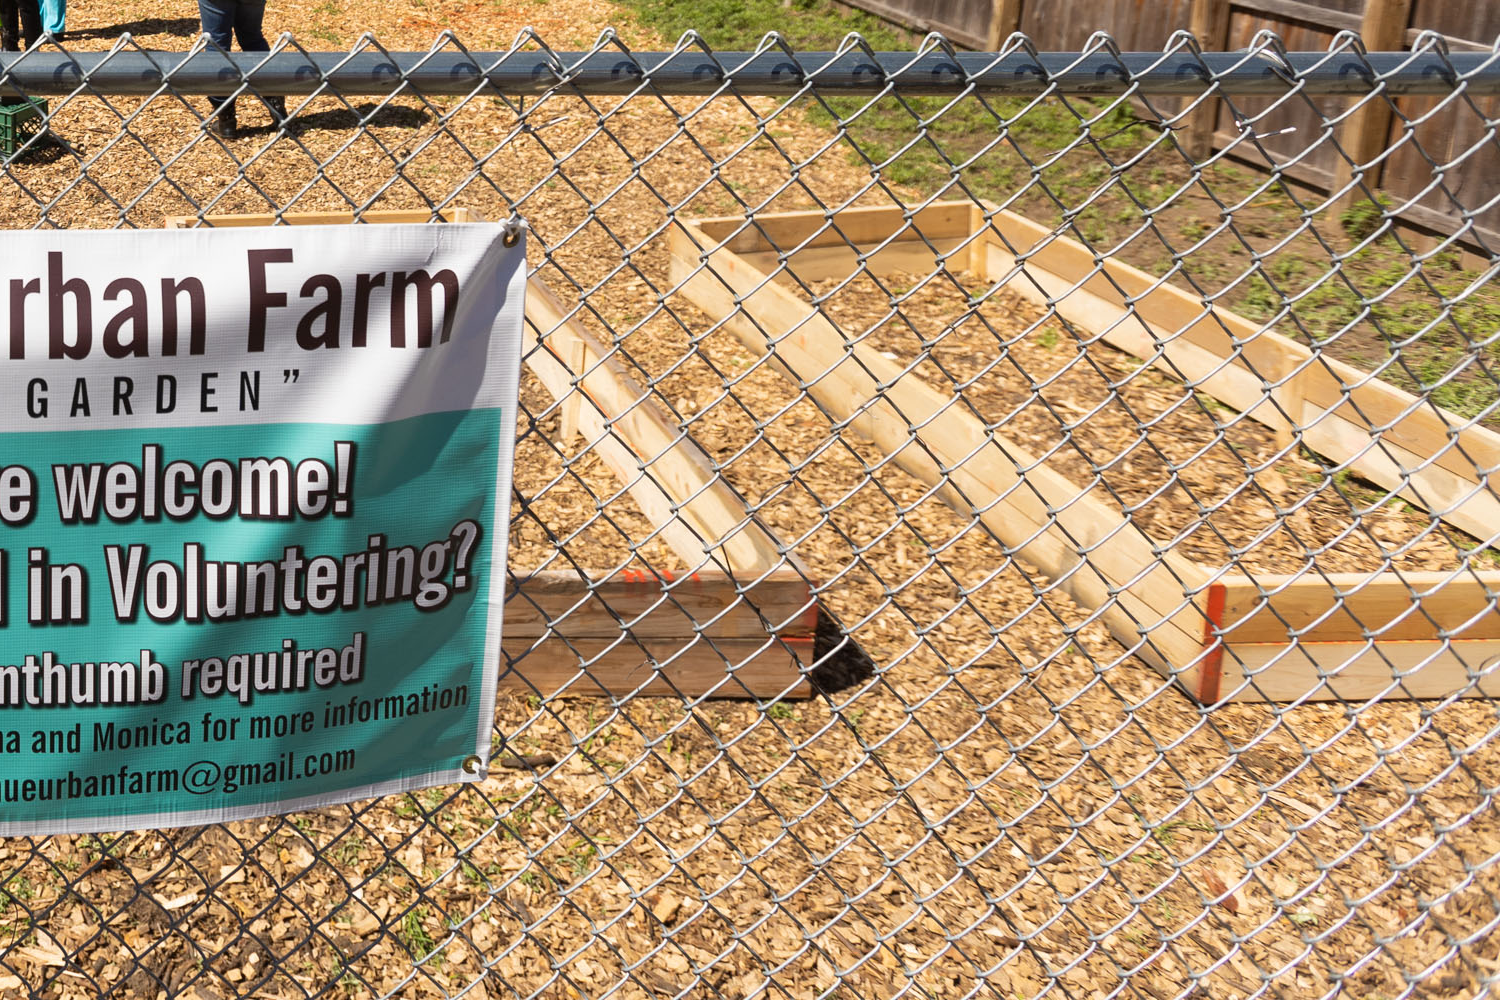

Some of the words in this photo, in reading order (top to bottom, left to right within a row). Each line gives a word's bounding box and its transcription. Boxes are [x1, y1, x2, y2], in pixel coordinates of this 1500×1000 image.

[246, 248, 461, 354] Farm
[52, 440, 354, 522] welcome!
[28, 547, 85, 624] in
[104, 518, 480, 621] Voluntering?
[181, 632, 364, 705] required
[31, 722, 82, 754] and
[92, 716, 191, 753] Monica
[200, 711, 241, 743] for
[249, 711, 315, 740] more
[323, 682, 468, 729] information
